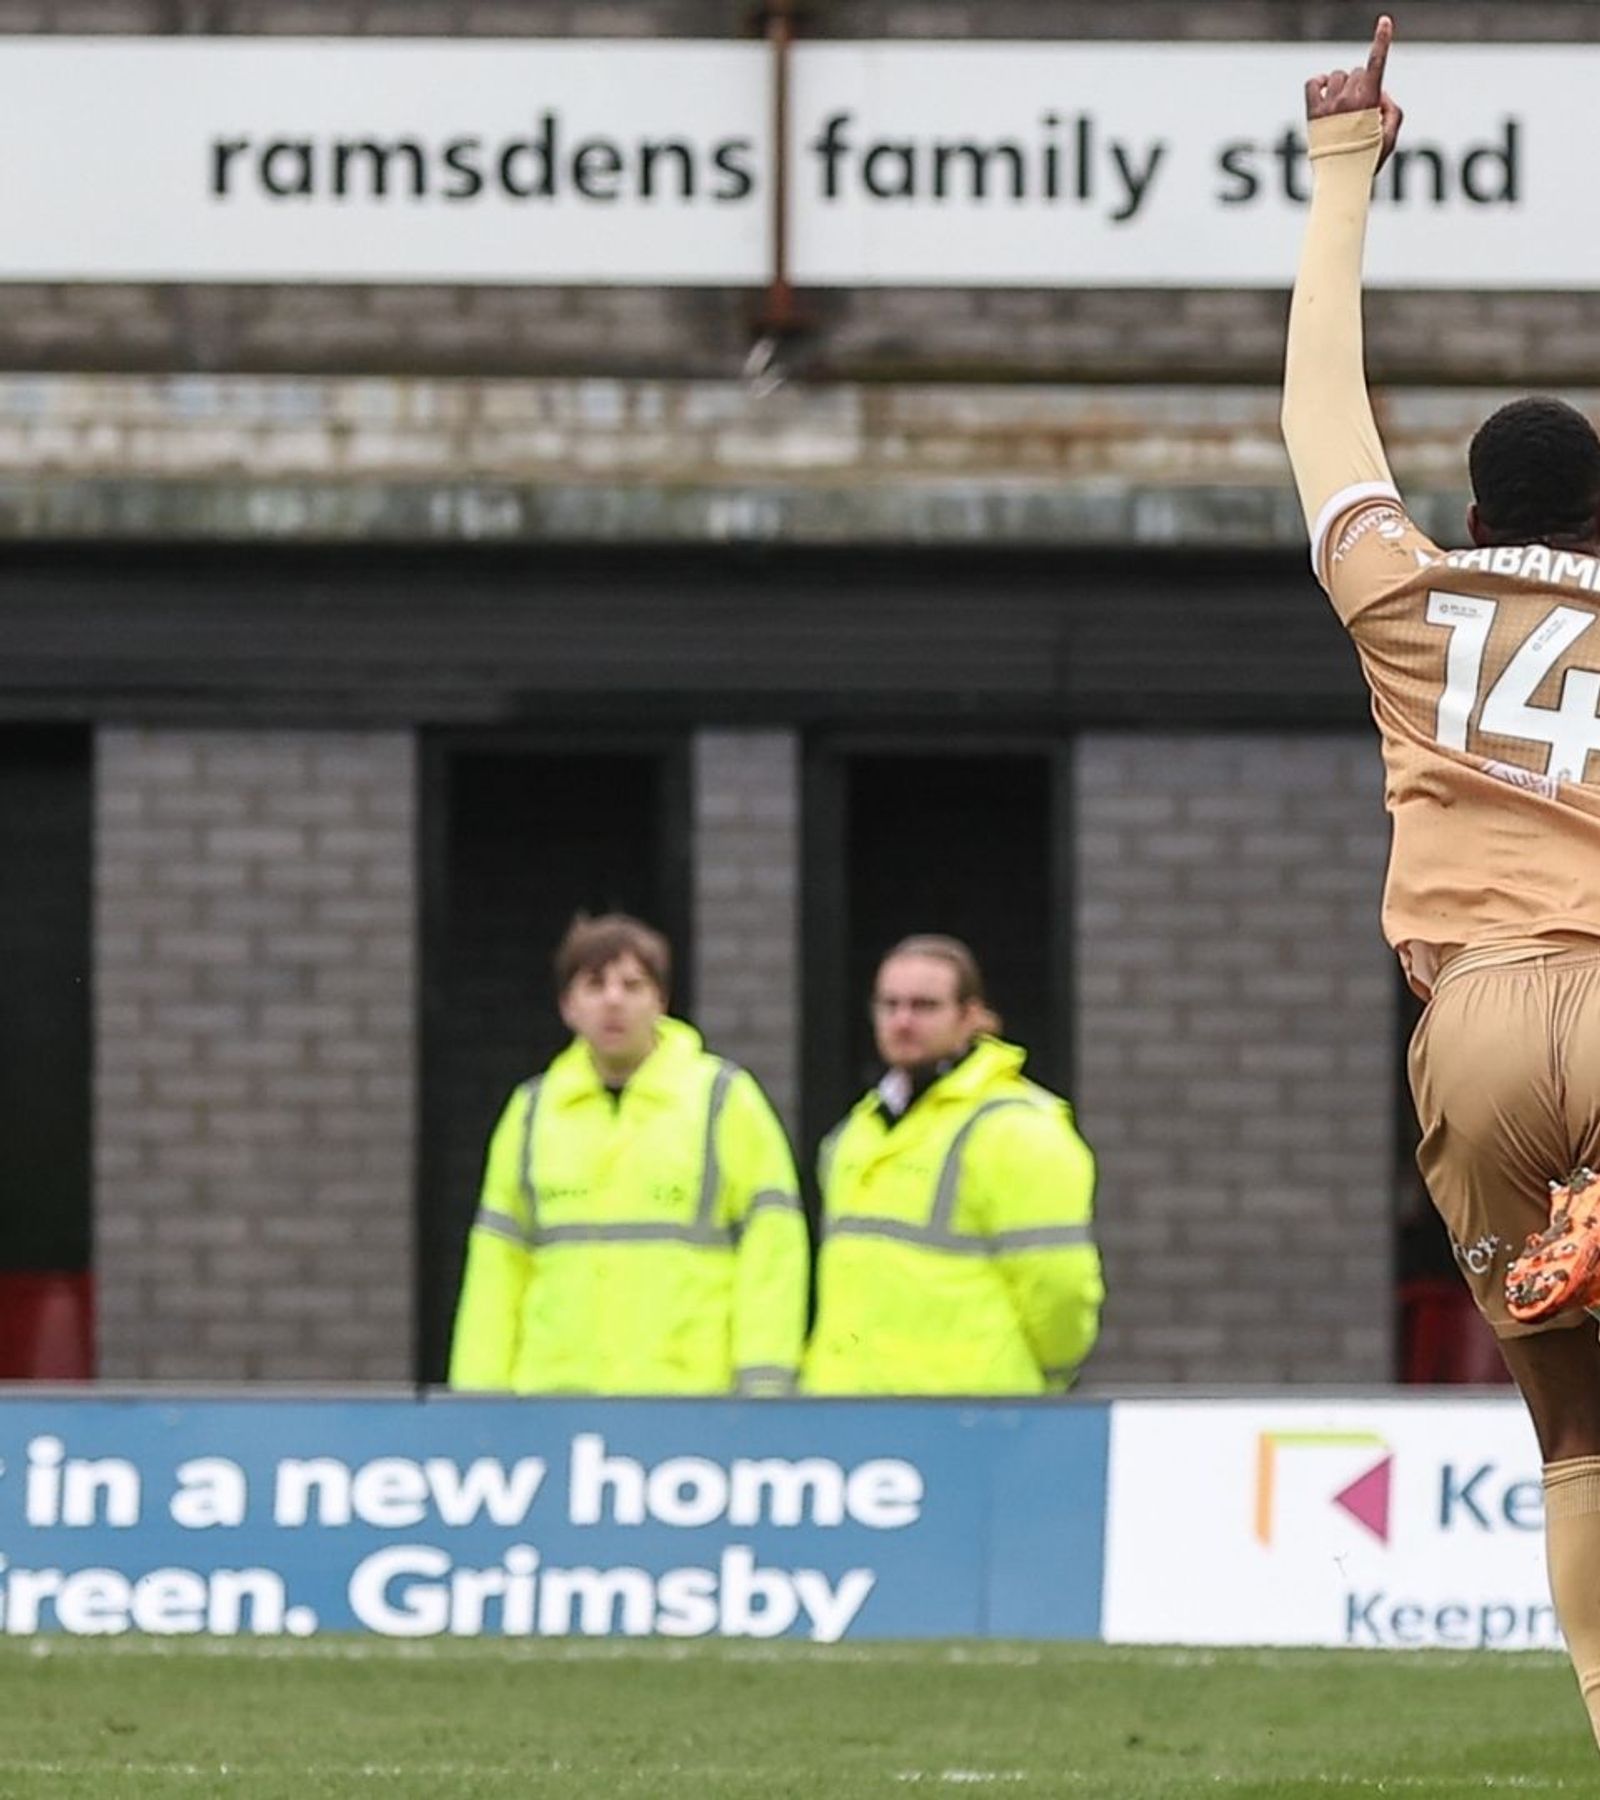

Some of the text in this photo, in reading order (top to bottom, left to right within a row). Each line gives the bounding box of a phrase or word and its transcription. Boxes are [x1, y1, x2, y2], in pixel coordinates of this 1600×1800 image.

[209, 110, 1522, 222] ramsdens family stnd
[26, 1432, 924, 1528] in a new home
[0, 1543, 876, 1643] reen. Grimsby
